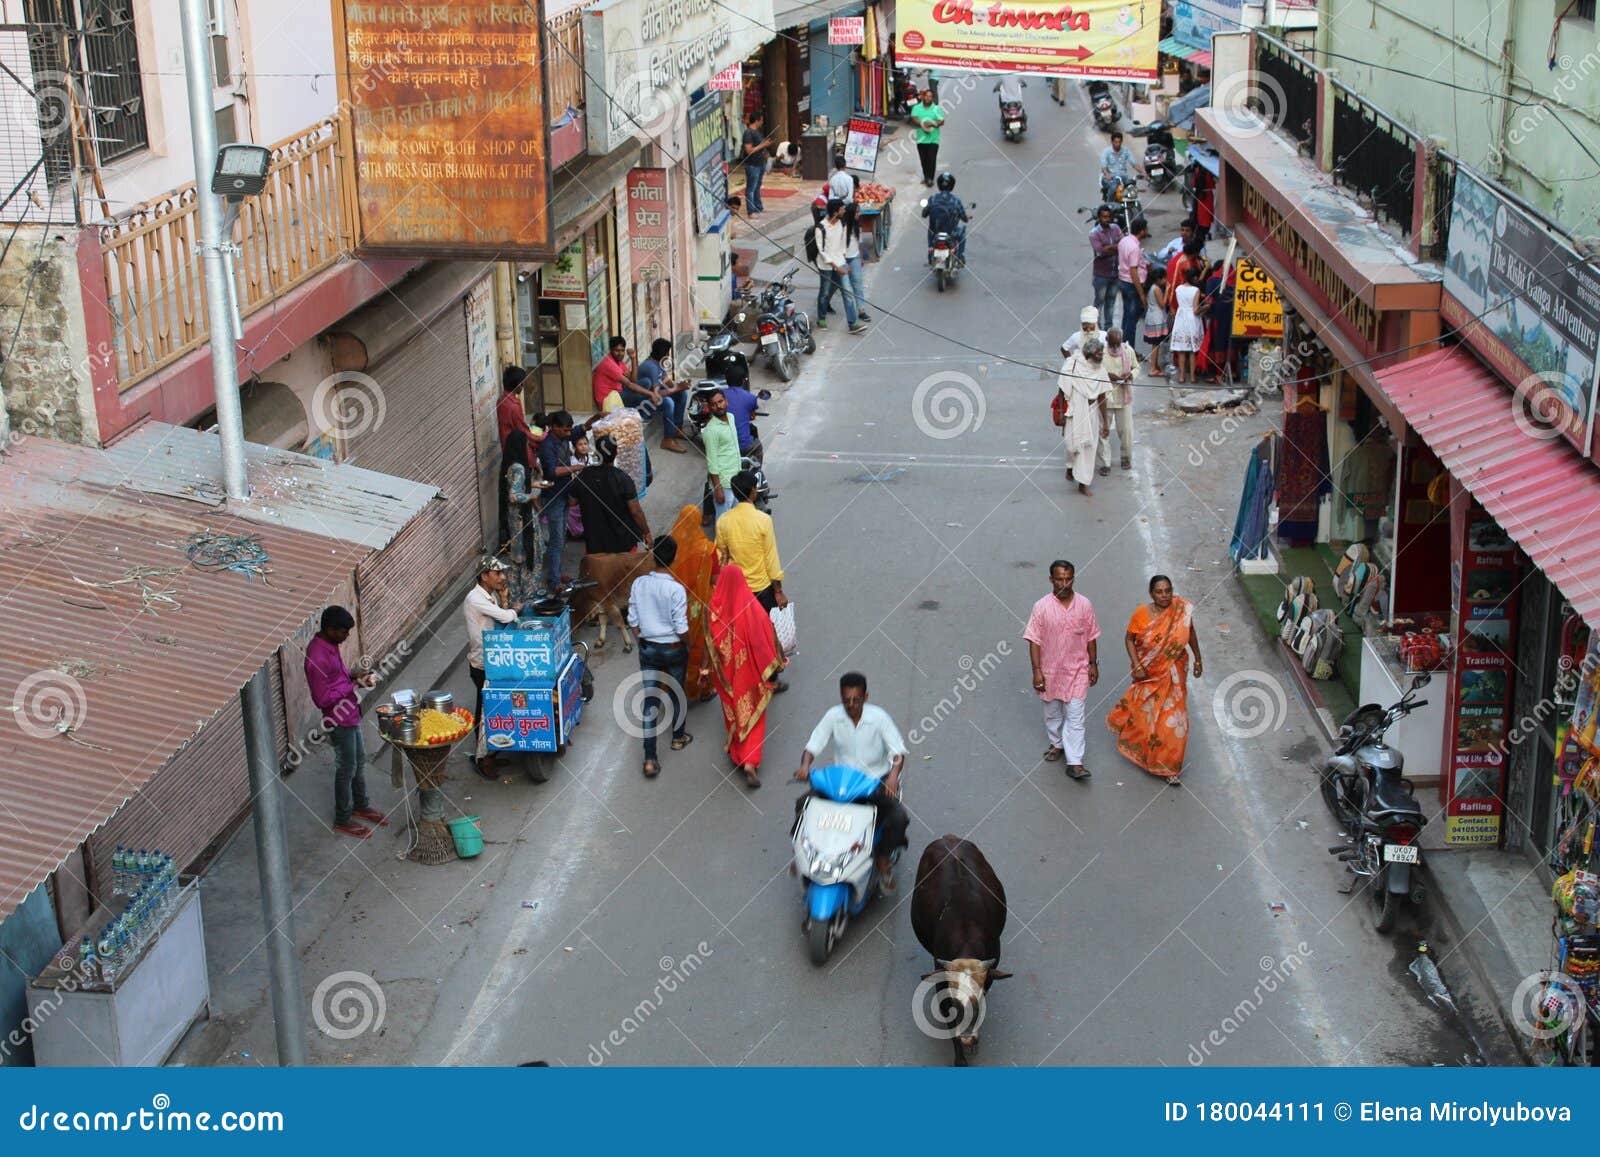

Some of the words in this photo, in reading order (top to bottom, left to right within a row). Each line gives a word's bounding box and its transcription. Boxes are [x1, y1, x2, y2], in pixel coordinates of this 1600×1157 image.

[829, 17, 862, 27] FOREIGN
[833, 27, 859, 36] MONEY
[851, 119, 881, 130] MONEY
[411, 140, 440, 154] ONLY
[444, 140, 476, 155] CLOTH
[482, 140, 516, 155] SHOP
[520, 140, 538, 155] OF
[359, 162, 382, 178] GITA
[385, 162, 417, 178] PRESS
[421, 162, 443, 178] GITA
[445, 162, 487, 178] BHAWAN
[514, 163, 536, 178] THE
[629, 181, 664, 201] गीता
[635, 207, 662, 229] प्रेस
[1237, 286, 1257, 307] मुनि
[1259, 287, 1274, 304] की
[1492, 242, 1507, 274] The
[1507, 253, 1527, 292] Rishi
[1527, 270, 1551, 315] Ganga
[1552, 294, 1596, 351] Adventure
[1465, 656, 1505, 667] Tracking
[1461, 706, 1482, 717] Bungy
[488, 713, 515, 731] छोले
[518, 714, 550, 736] कुल्चे
[1456, 754, 1469, 763] Wild
[1470, 754, 1482, 763] Life
